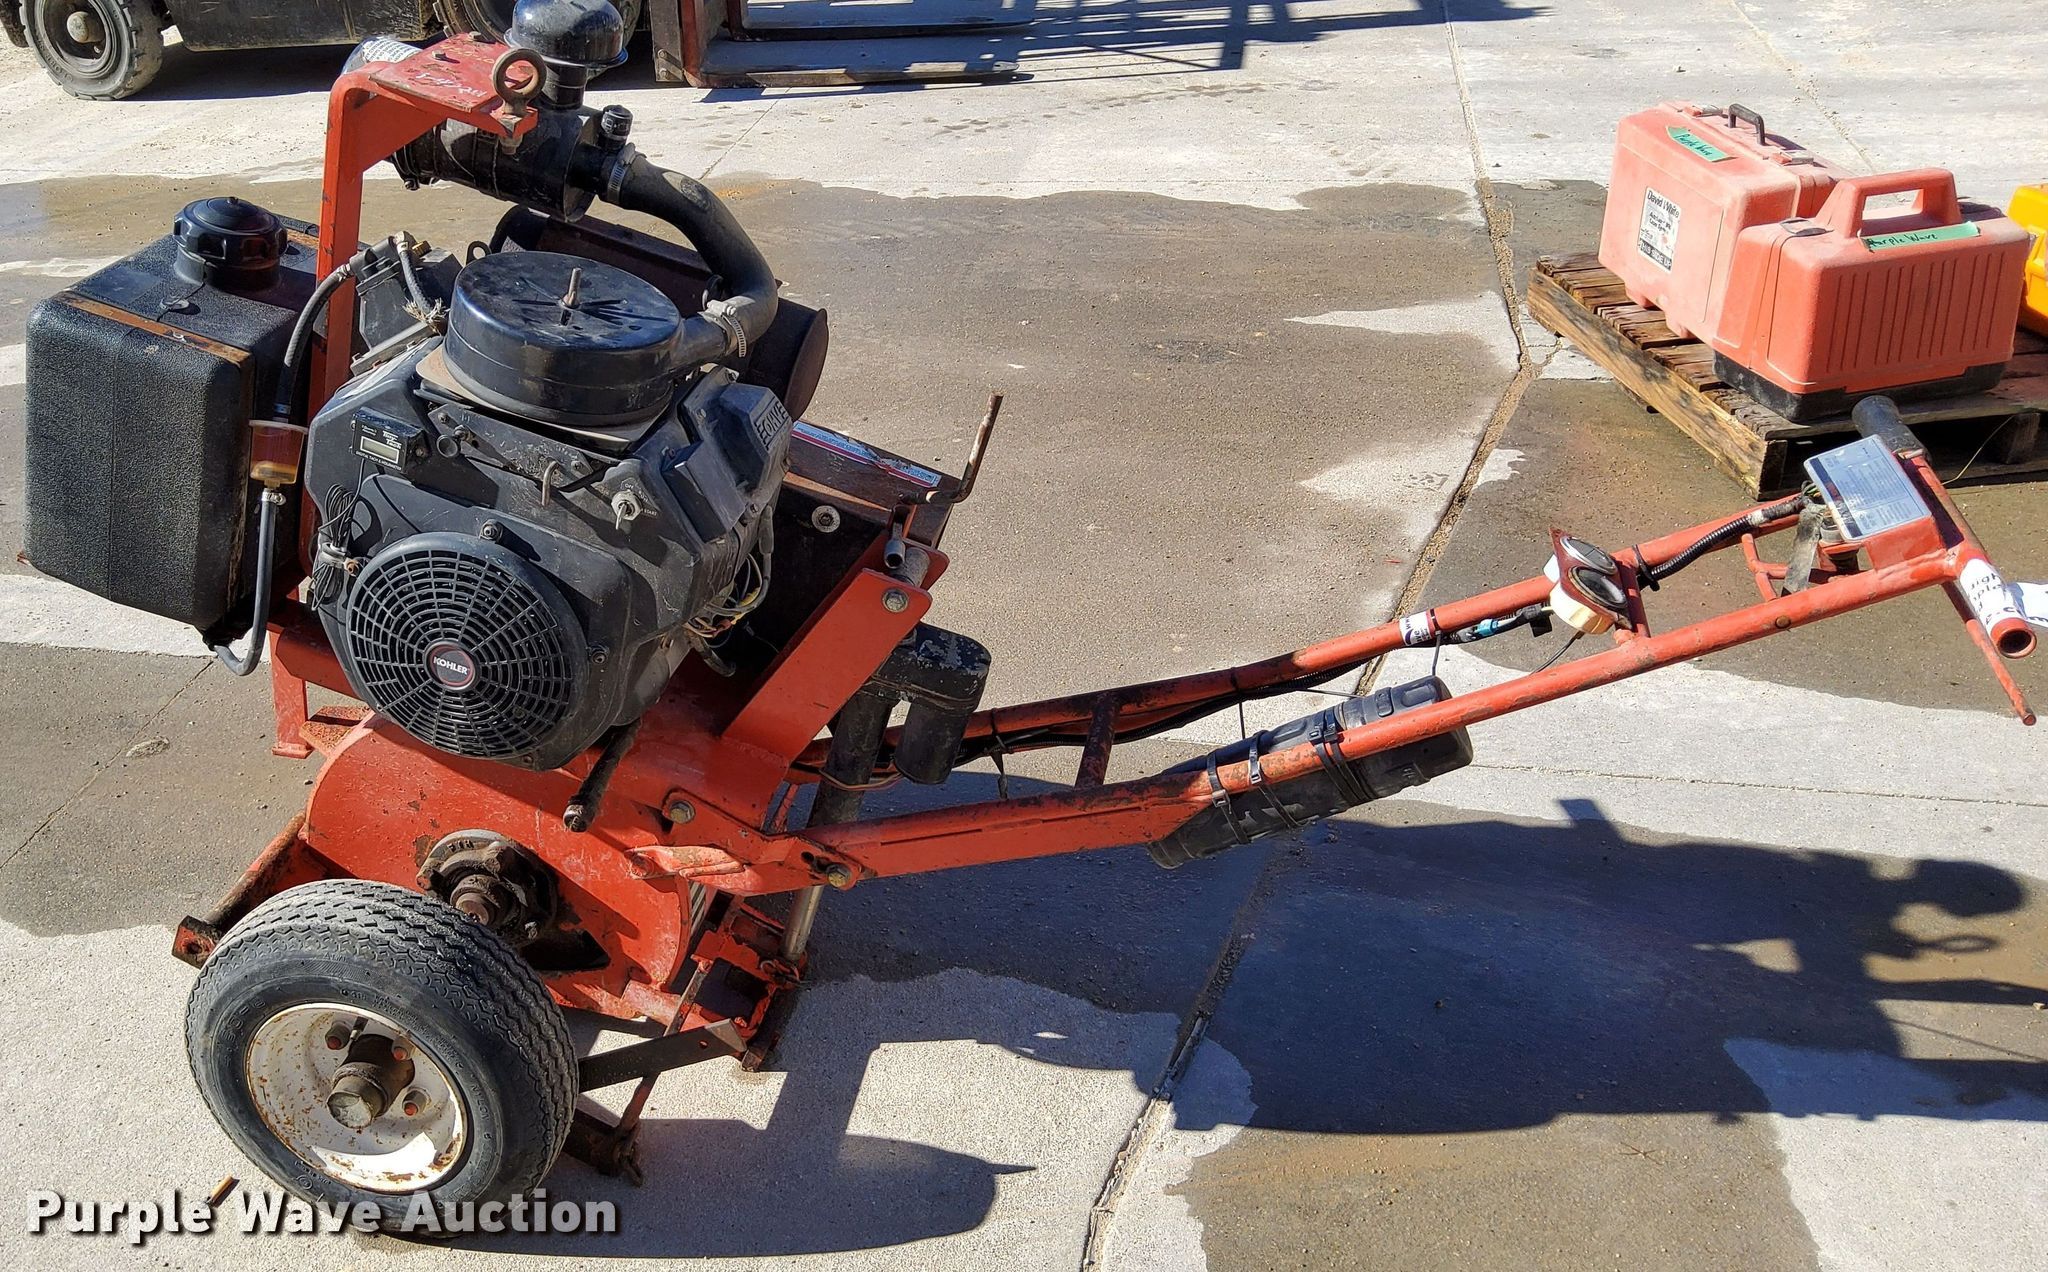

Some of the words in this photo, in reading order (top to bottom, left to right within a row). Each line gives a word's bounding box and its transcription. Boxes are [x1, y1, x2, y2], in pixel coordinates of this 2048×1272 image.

[1647, 190, 1663, 207] David
[1663, 200, 1680, 218] White
[433, 656, 468, 675] KOHLER
